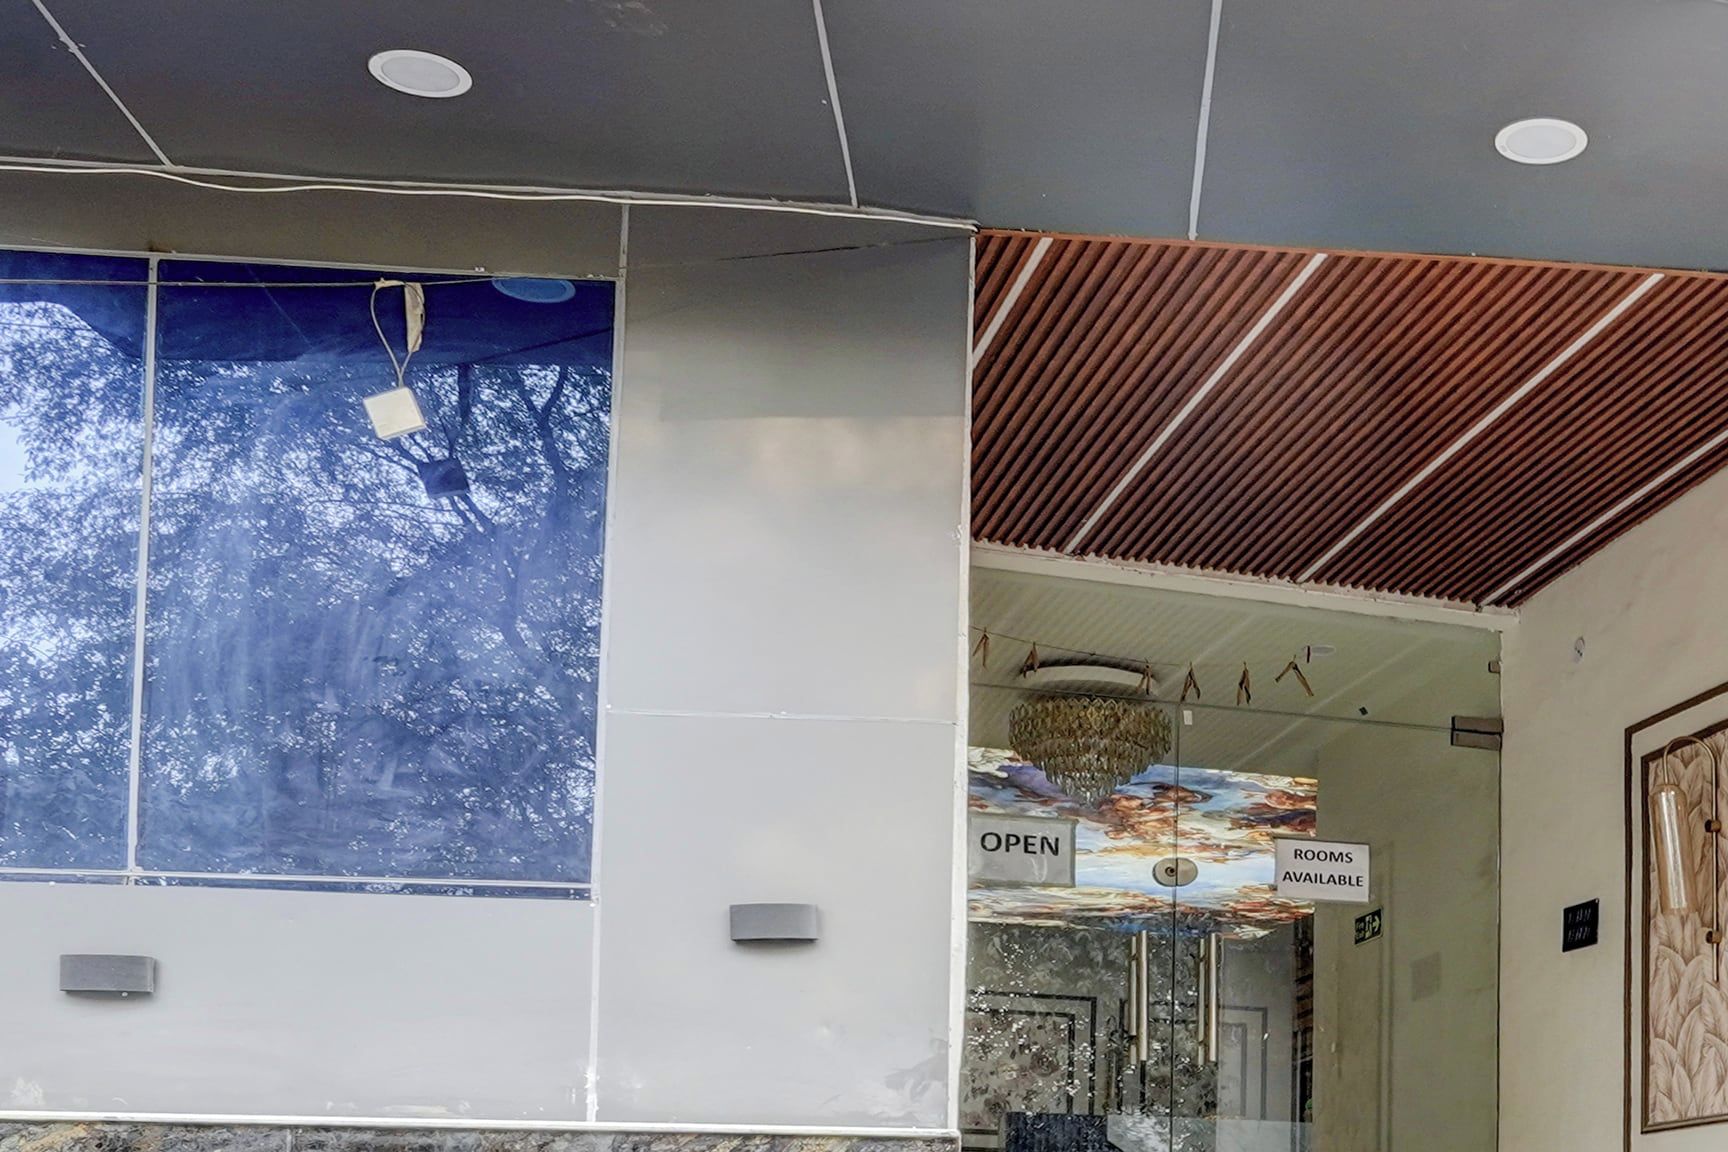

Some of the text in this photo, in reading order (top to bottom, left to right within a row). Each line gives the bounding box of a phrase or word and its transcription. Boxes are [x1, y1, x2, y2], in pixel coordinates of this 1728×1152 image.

[980, 831, 1060, 857] OPEN
[1293, 848, 1353, 864] ROOMS
[1282, 870, 1364, 888] AVAILABLE
